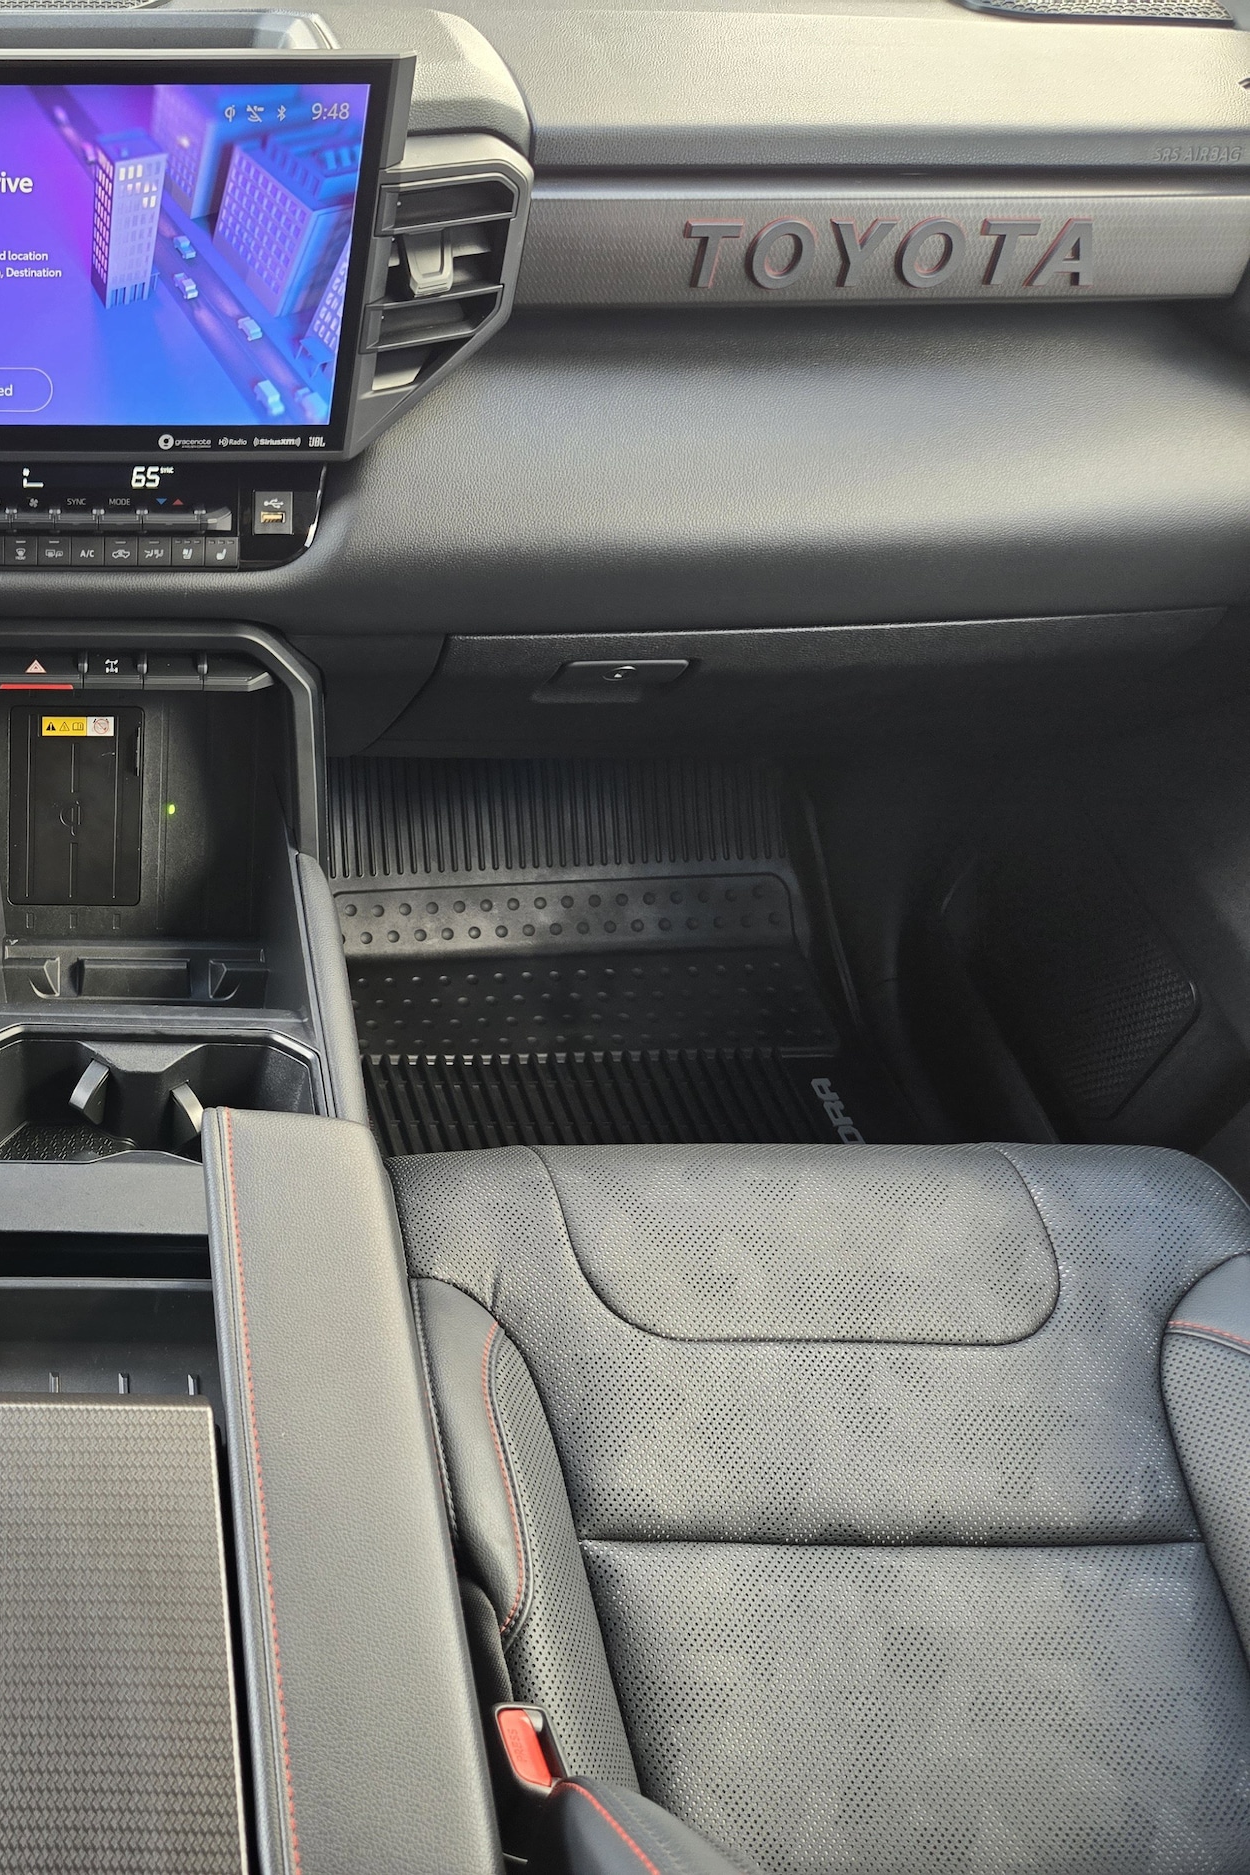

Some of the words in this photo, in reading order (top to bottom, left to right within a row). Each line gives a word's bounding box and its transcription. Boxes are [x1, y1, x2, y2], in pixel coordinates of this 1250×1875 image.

[311, 102, 350, 121] 9:48
[1154, 147, 1181, 161] SRS
[1183, 146, 1242, 161] AIRBAG
[8, 250, 48, 261] location
[683, 216, 1095, 291] TOYOTA
[6, 267, 62, 278] Destination
[131, 466, 160, 489] 65
[66, 498, 86, 506] SYNC
[109, 498, 131, 506] MODE
[80, 549, 94, 558] A/C
